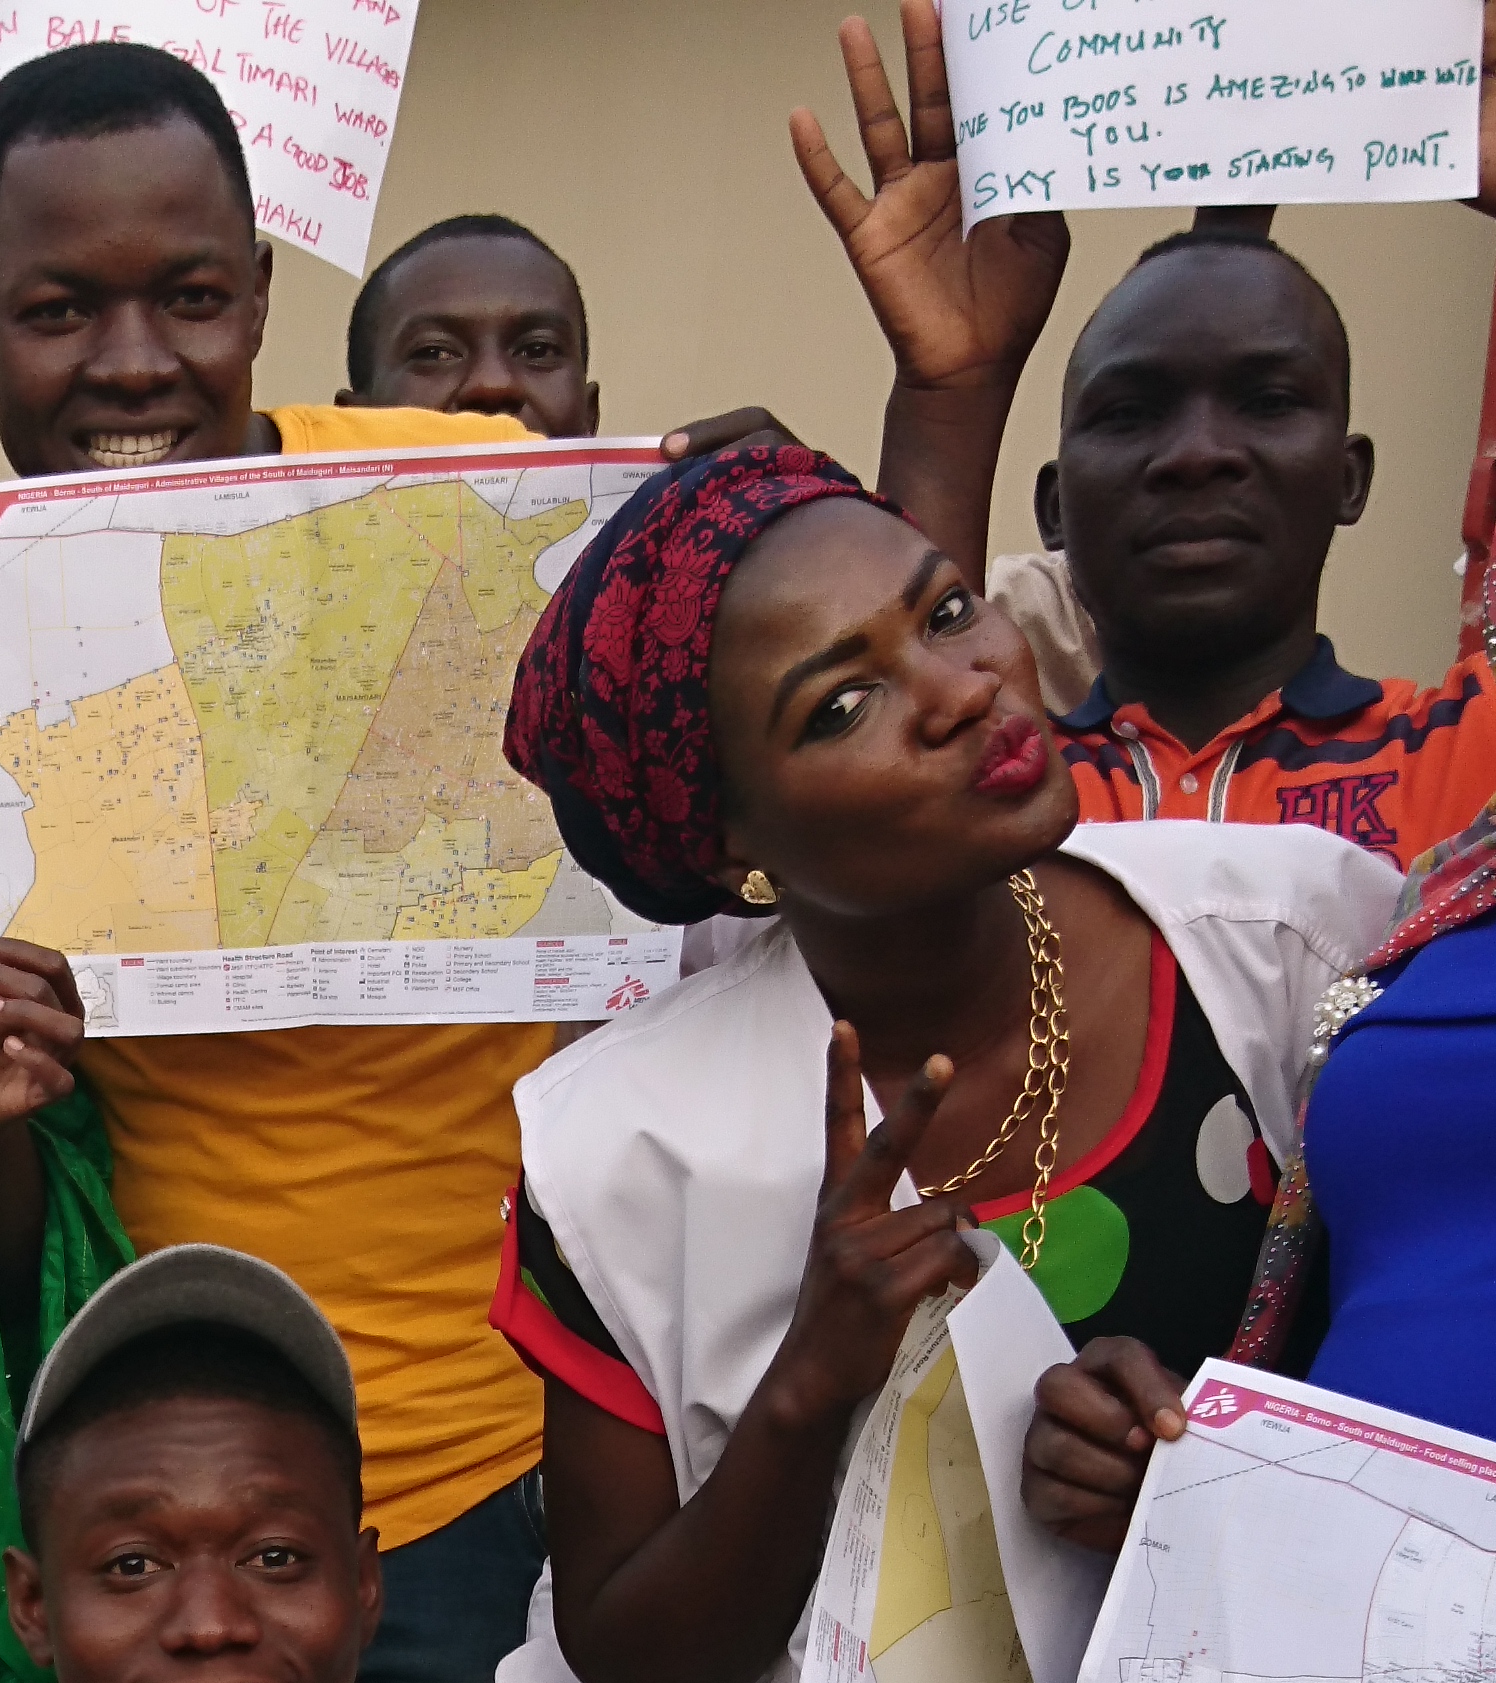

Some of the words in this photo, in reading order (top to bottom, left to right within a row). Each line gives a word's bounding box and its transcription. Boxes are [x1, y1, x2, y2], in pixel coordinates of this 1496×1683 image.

[262, 0, 305, 44] THE
[969, 0, 1030, 41] USE
[1028, 15, 1226, 75] COMMUNITY
[1000, 102, 1045, 132] YOU
[1063, 85, 1137, 121] BOOS
[1165, 83, 1188, 106] IS
[1341, 65, 1366, 91] TO
[251, 122, 273, 148] A
[283, 136, 328, 173] GOOD
[335, 103, 388, 146] WARD.
[1071, 122, 1162, 155] YOU.
[973, 168, 1054, 209] SKY
[1089, 163, 1120, 191] IS
[1363, 130, 1457, 181] POINT.
[17, 488, 47, 497] NIGERIA
[53, 486, 74, 495] Borno
[81, 484, 100, 493] South
[102, 483, 111, 491] of
[112, 480, 149, 490] Maiduguri
[154, 476, 208, 487] Administrative
[209, 474, 237, 483] Villages
[239, 473, 247, 481] of
[249, 472, 260, 480] the
[262, 470, 284, 479] South
[286, 469, 295, 477] of
[295, 466, 332, 477] Maiduguri
[338, 462, 380, 473] Maisandari
[382, 461, 393, 470] (N)
[1263, 1399, 1299, 1418] NIGERIA
[1305, 1411, 1332, 1427] Borno
[1336, 1421, 1363, 1437] South
[1363, 1429, 1374, 1440] of
[1423, 1446, 1447, 1462] Food
[1447, 1453, 1478, 1471] selling
